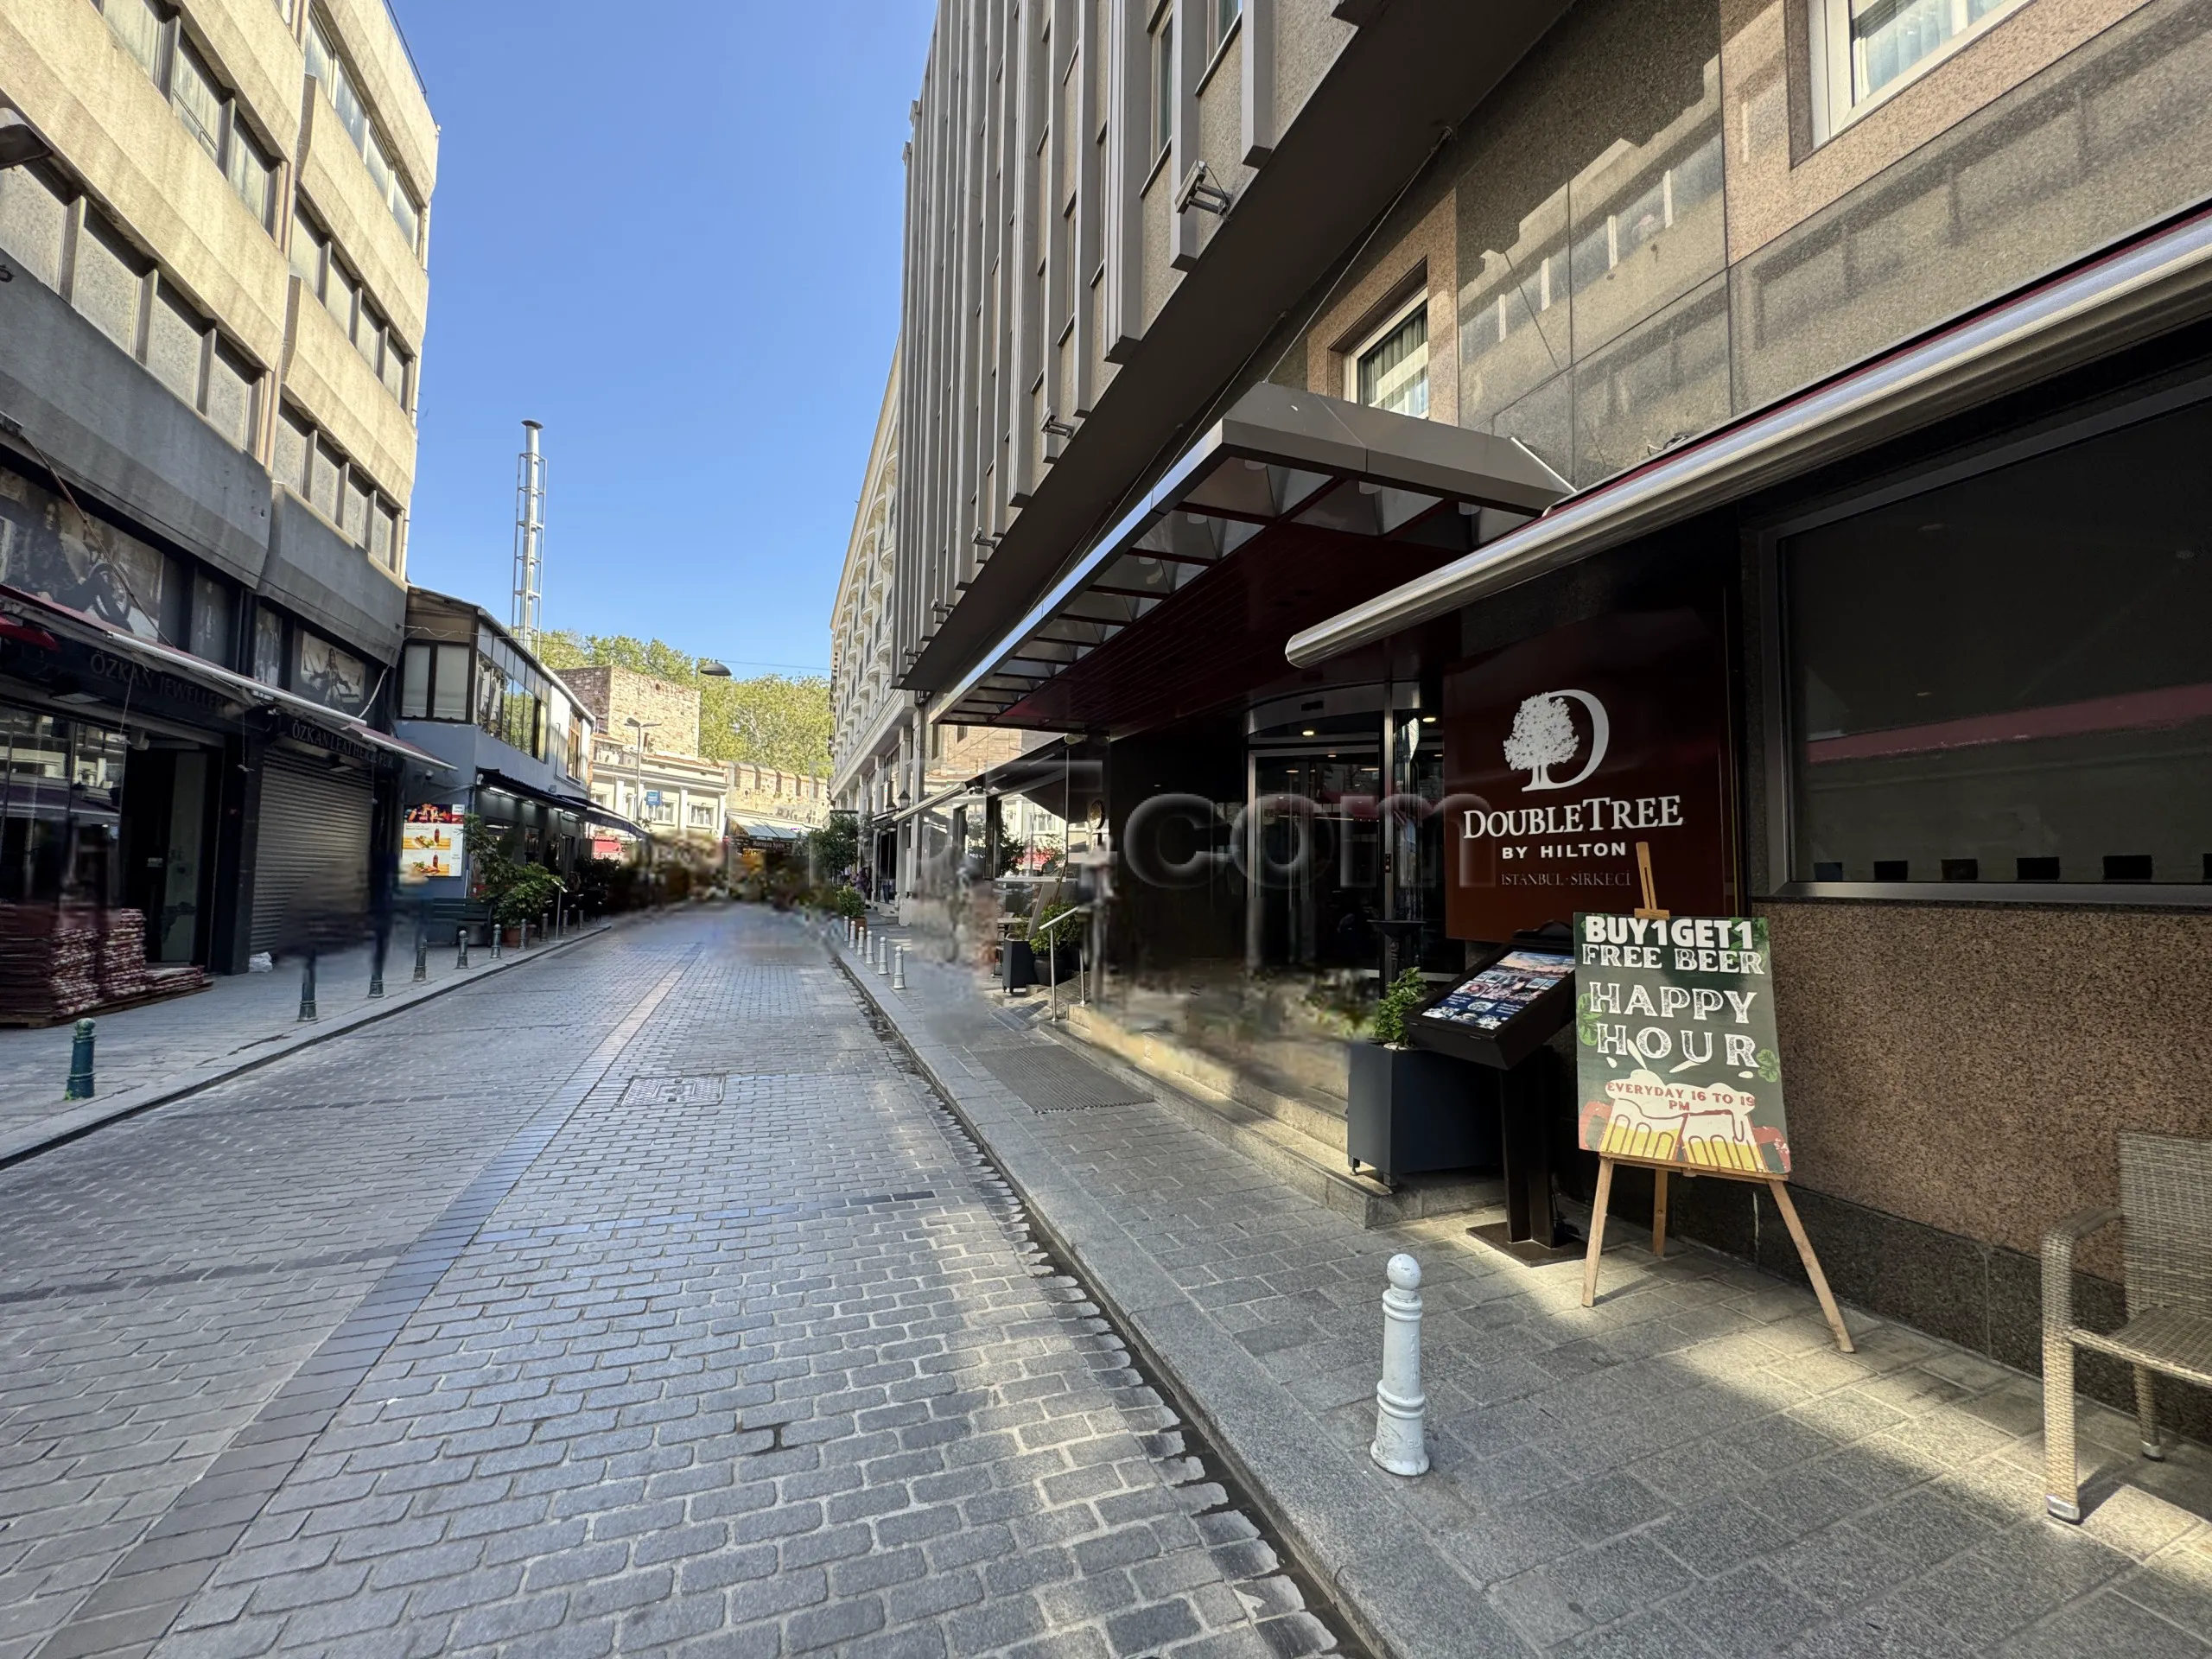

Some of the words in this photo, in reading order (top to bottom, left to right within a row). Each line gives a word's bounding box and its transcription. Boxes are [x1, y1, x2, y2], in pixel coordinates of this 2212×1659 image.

[1502, 847, 1528, 859] BY
[1541, 842, 1626, 858] HILTON
[1582, 944, 1662, 969] FREE
[1674, 949, 1765, 975] BEER
[1589, 982, 1758, 1025] HAPPY
[1597, 1023, 1760, 1068] HOUR
[1606, 1082, 1684, 1099] EVERYDAY
[1691, 1090, 1707, 1102] 16
[1713, 1093, 1733, 1104] TO
[1740, 1096, 1756, 1107] 19
[1669, 1099, 1690, 1111] PM
